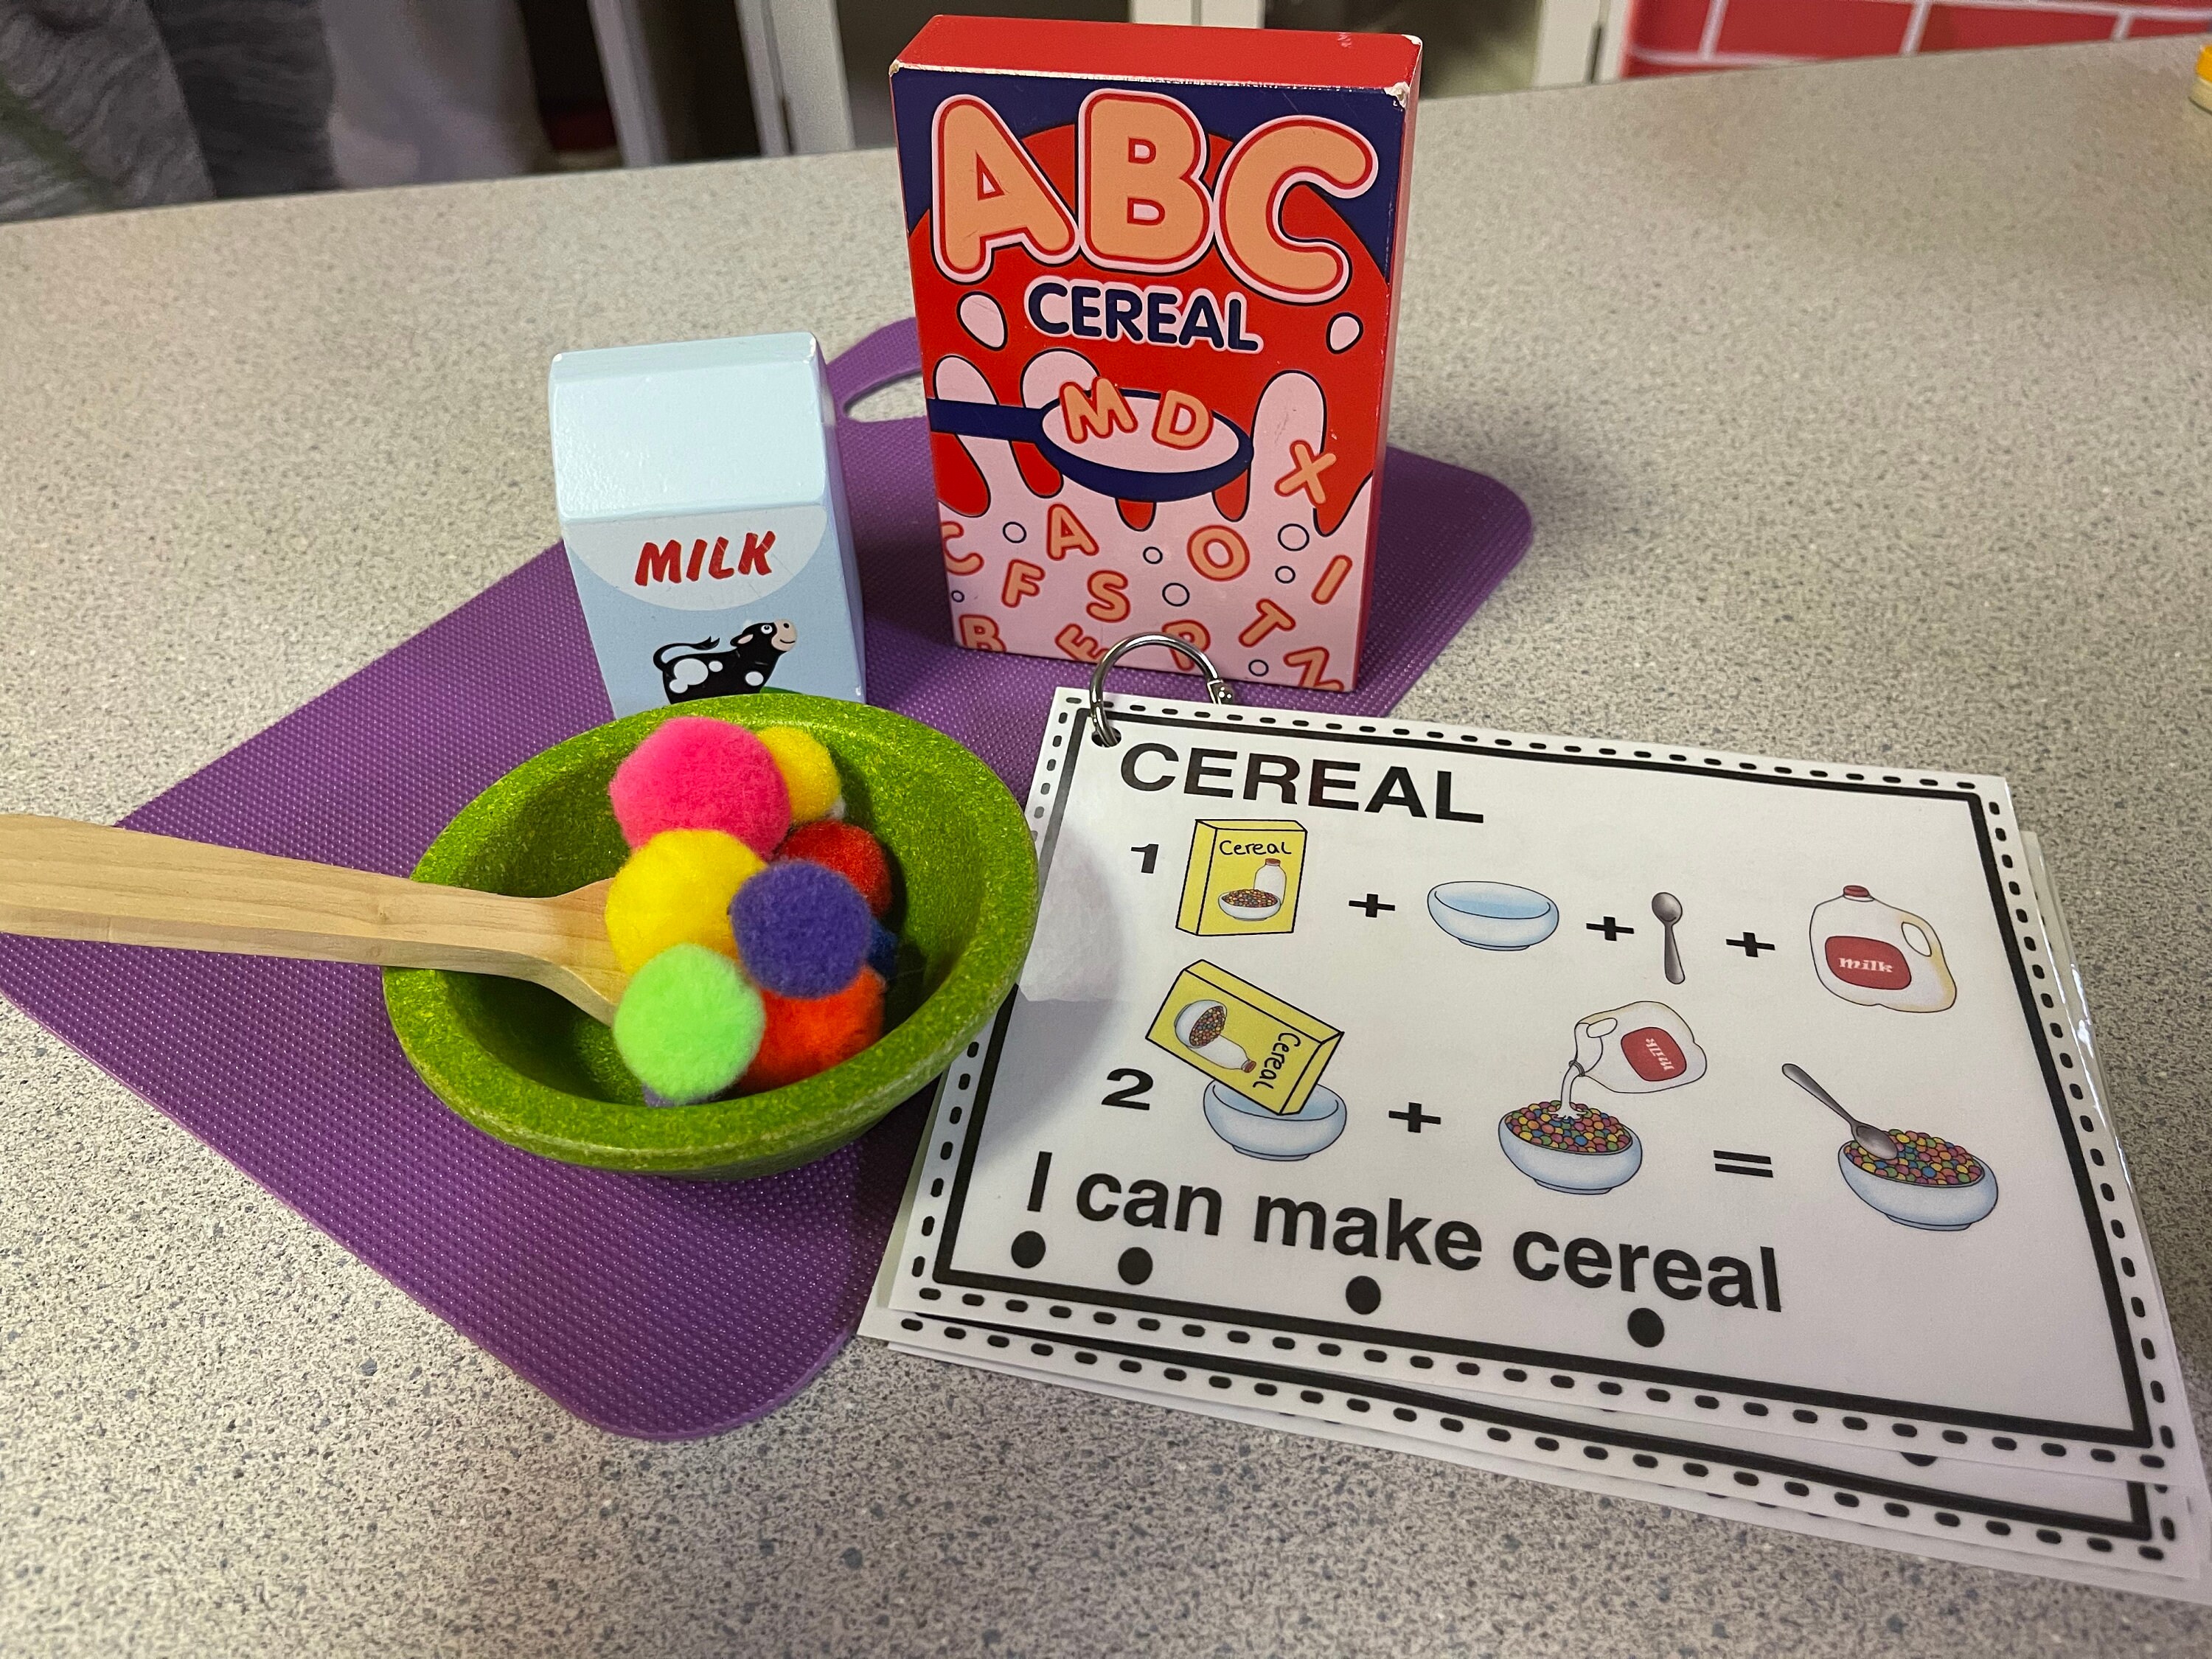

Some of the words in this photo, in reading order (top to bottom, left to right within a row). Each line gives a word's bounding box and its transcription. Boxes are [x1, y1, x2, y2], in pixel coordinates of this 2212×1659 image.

[933, 89, 1377, 303] ABC
[1026, 279, 1261, 352] CEREAL
[1059, 378, 1137, 442] M
[1152, 390, 1213, 450] D
[1275, 439, 1336, 509] X
[635, 530, 776, 586] MILK
[1047, 504, 1099, 560] A
[1186, 524, 1250, 580] O
[1001, 559, 1046, 608] F
[1086, 570, 1131, 623] S
[1239, 599, 1295, 647] T
[1120, 742, 1484, 824] CEREAL
[1130, 844, 1160, 874] 1
[1220, 840, 1292, 855] Cereal
[1839, 958, 1893, 973] milk
[1253, 1032, 1301, 1089] Cereal
[1645, 1037, 1675, 1071] milk
[1101, 1068, 1154, 1110] 2
[1027, 1151, 1052, 1212] I
[1076, 1172, 1222, 1236] can
[1254, 1194, 1482, 1270] make
[1513, 1230, 1781, 1312] cereal
